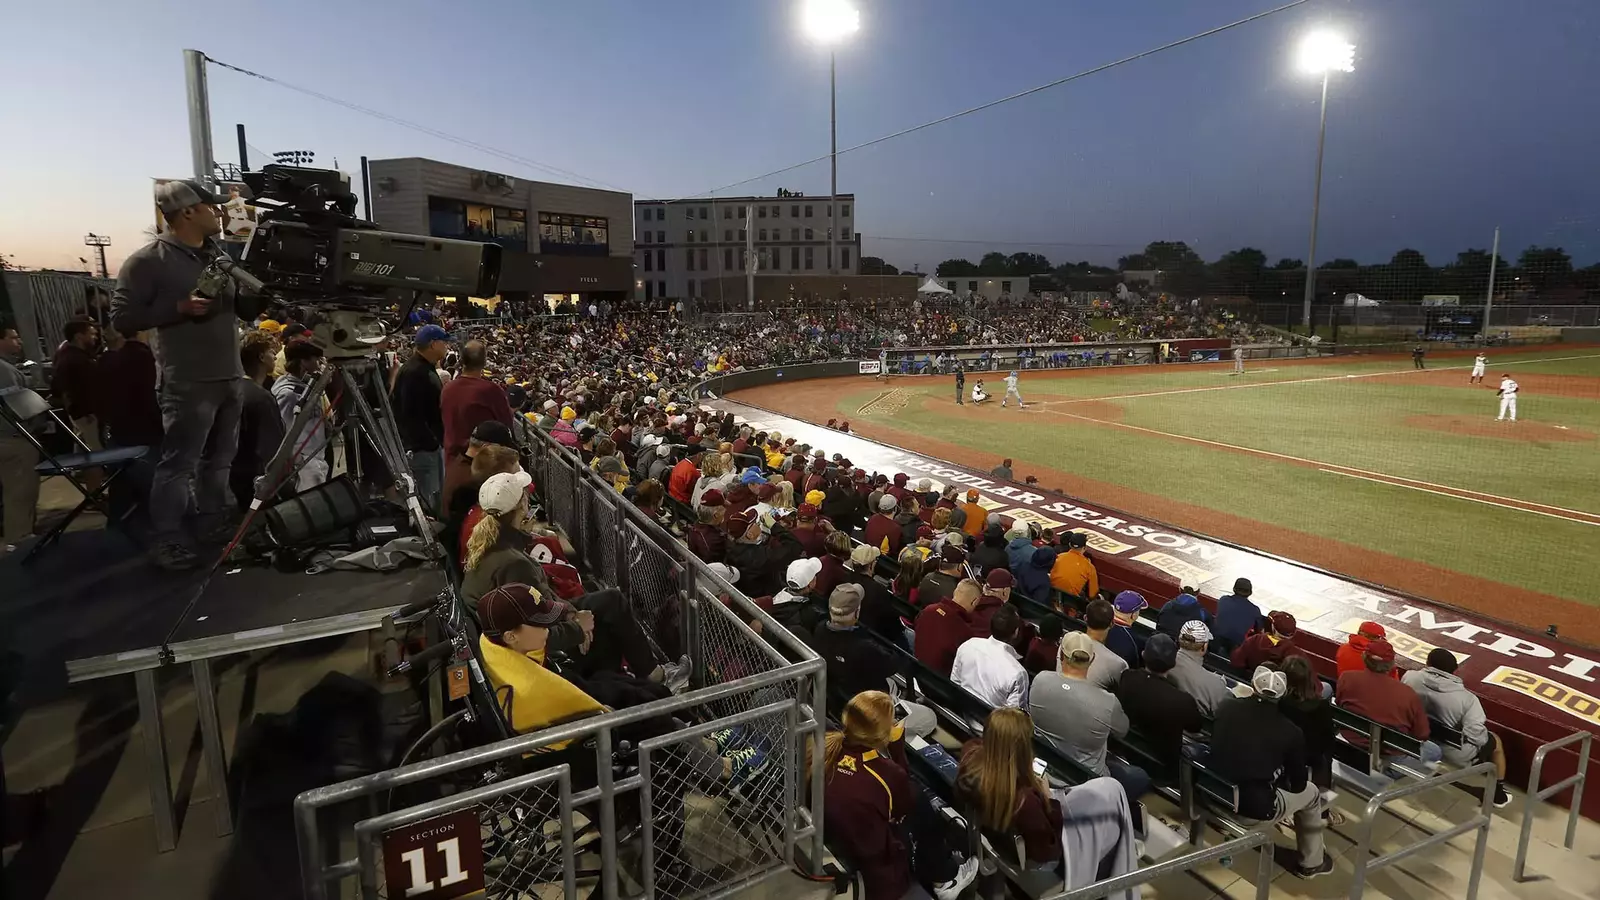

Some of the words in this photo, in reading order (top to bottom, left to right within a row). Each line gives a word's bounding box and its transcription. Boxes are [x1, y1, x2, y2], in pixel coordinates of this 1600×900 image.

[277, 240, 283, 250] 1
[374, 264, 395, 275] 101
[895, 458, 1045, 505] REGULAR
[1040, 502, 1222, 561] SEASON
[1502, 672, 1600, 719] 200
[410, 823, 455, 842] SECTION
[401, 837, 468, 898] 11
